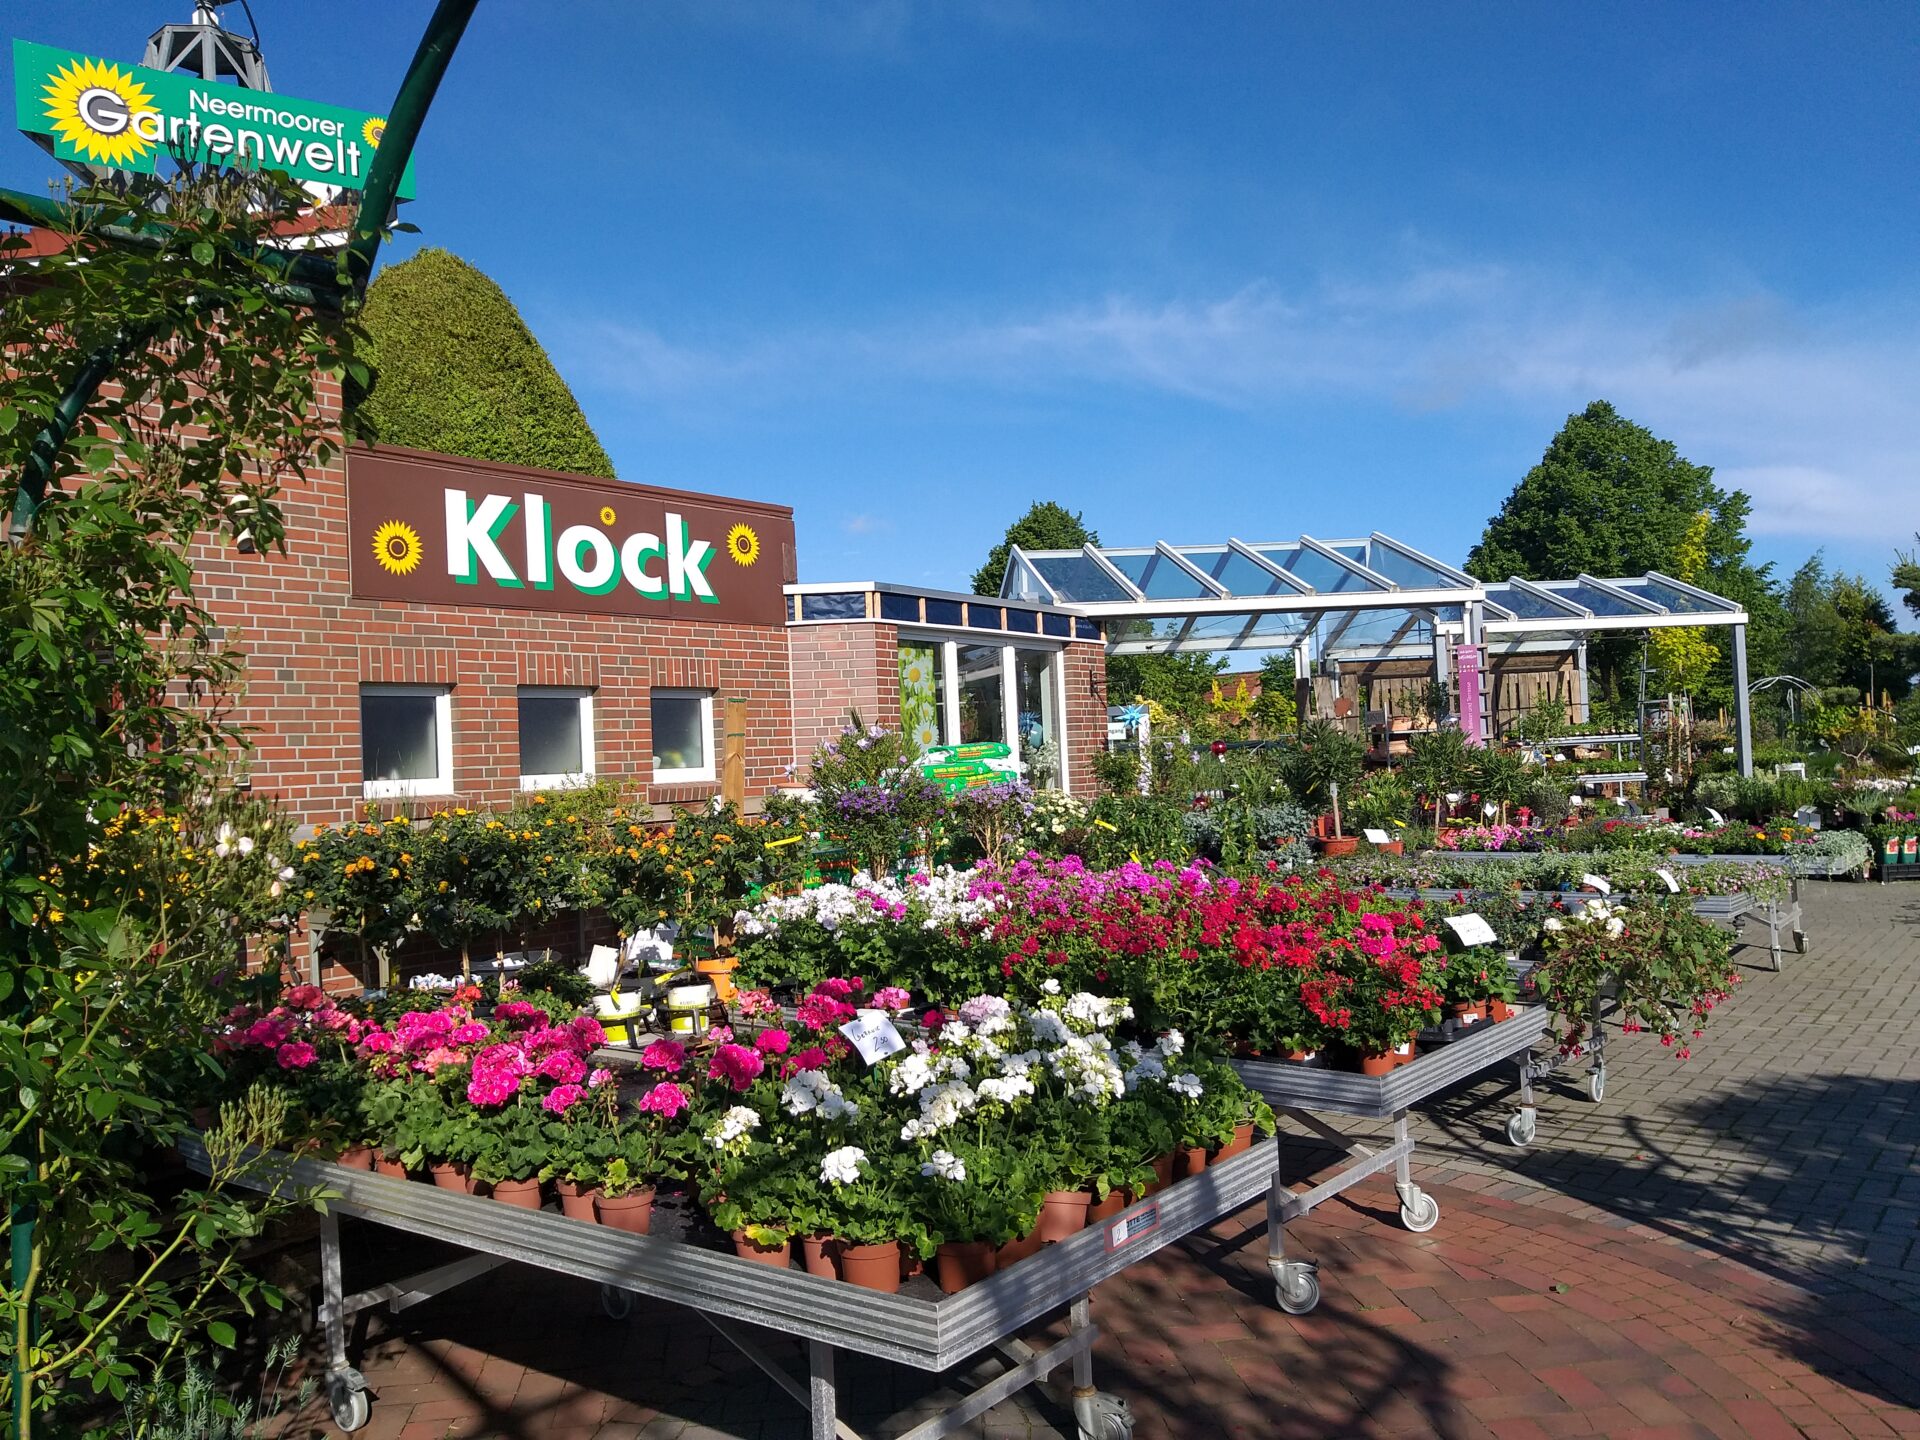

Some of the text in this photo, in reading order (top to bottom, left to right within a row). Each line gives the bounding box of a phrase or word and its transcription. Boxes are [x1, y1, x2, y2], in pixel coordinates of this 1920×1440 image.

[77, 88, 362, 178] Gartenwelt
[189, 89, 345, 138] Neermoorer
[444, 488, 720, 604] Klock
